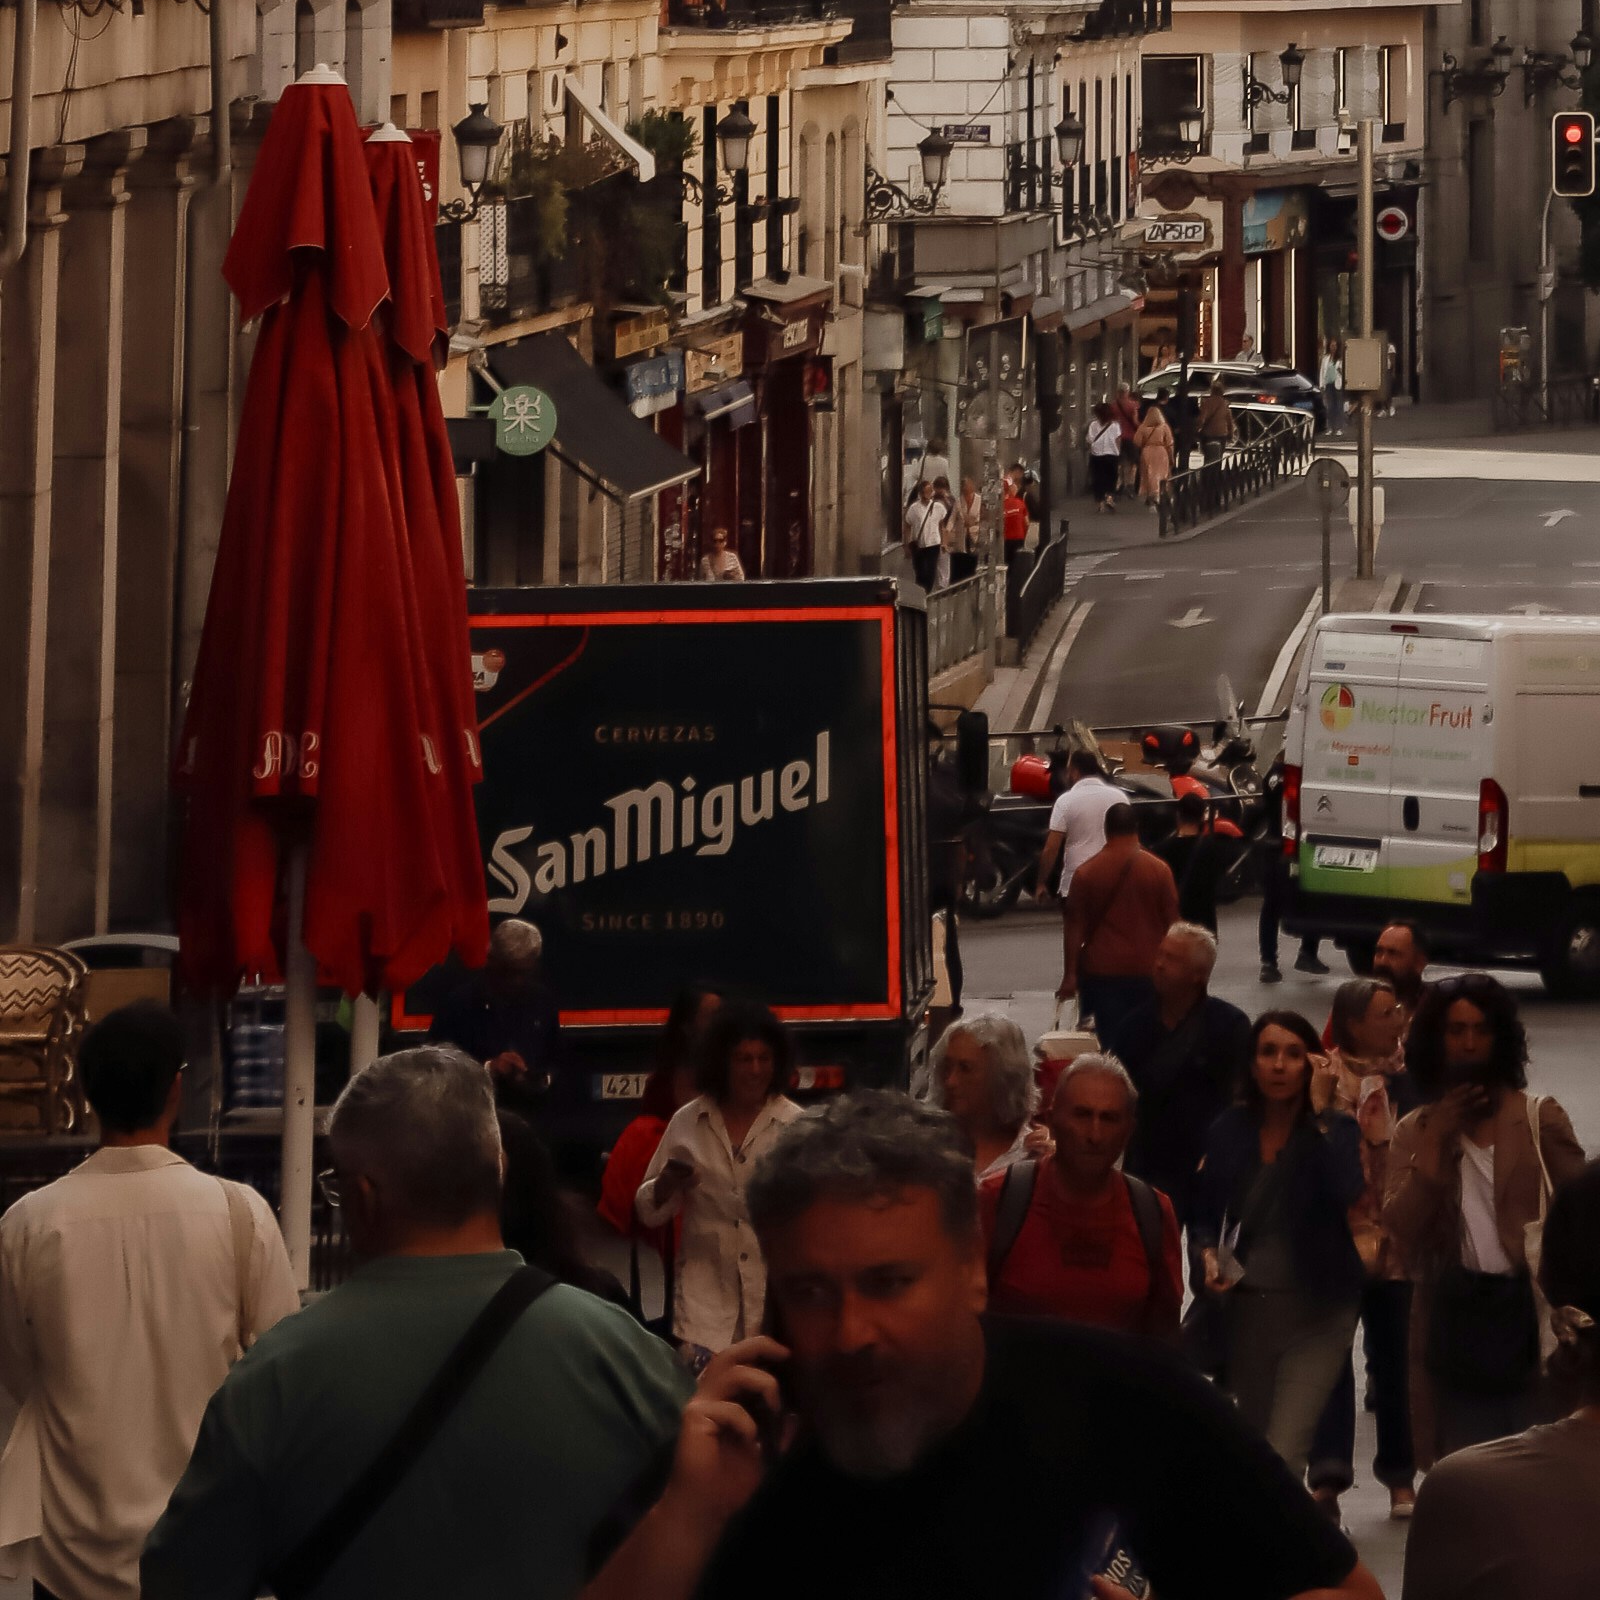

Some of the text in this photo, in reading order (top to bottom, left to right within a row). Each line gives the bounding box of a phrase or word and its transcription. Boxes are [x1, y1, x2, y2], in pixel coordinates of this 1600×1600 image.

[1147, 223, 1202, 241] ZAPSHOP
[593, 723, 717, 744] CERVEZAS
[580, 910, 725, 931] SINCE 1890
